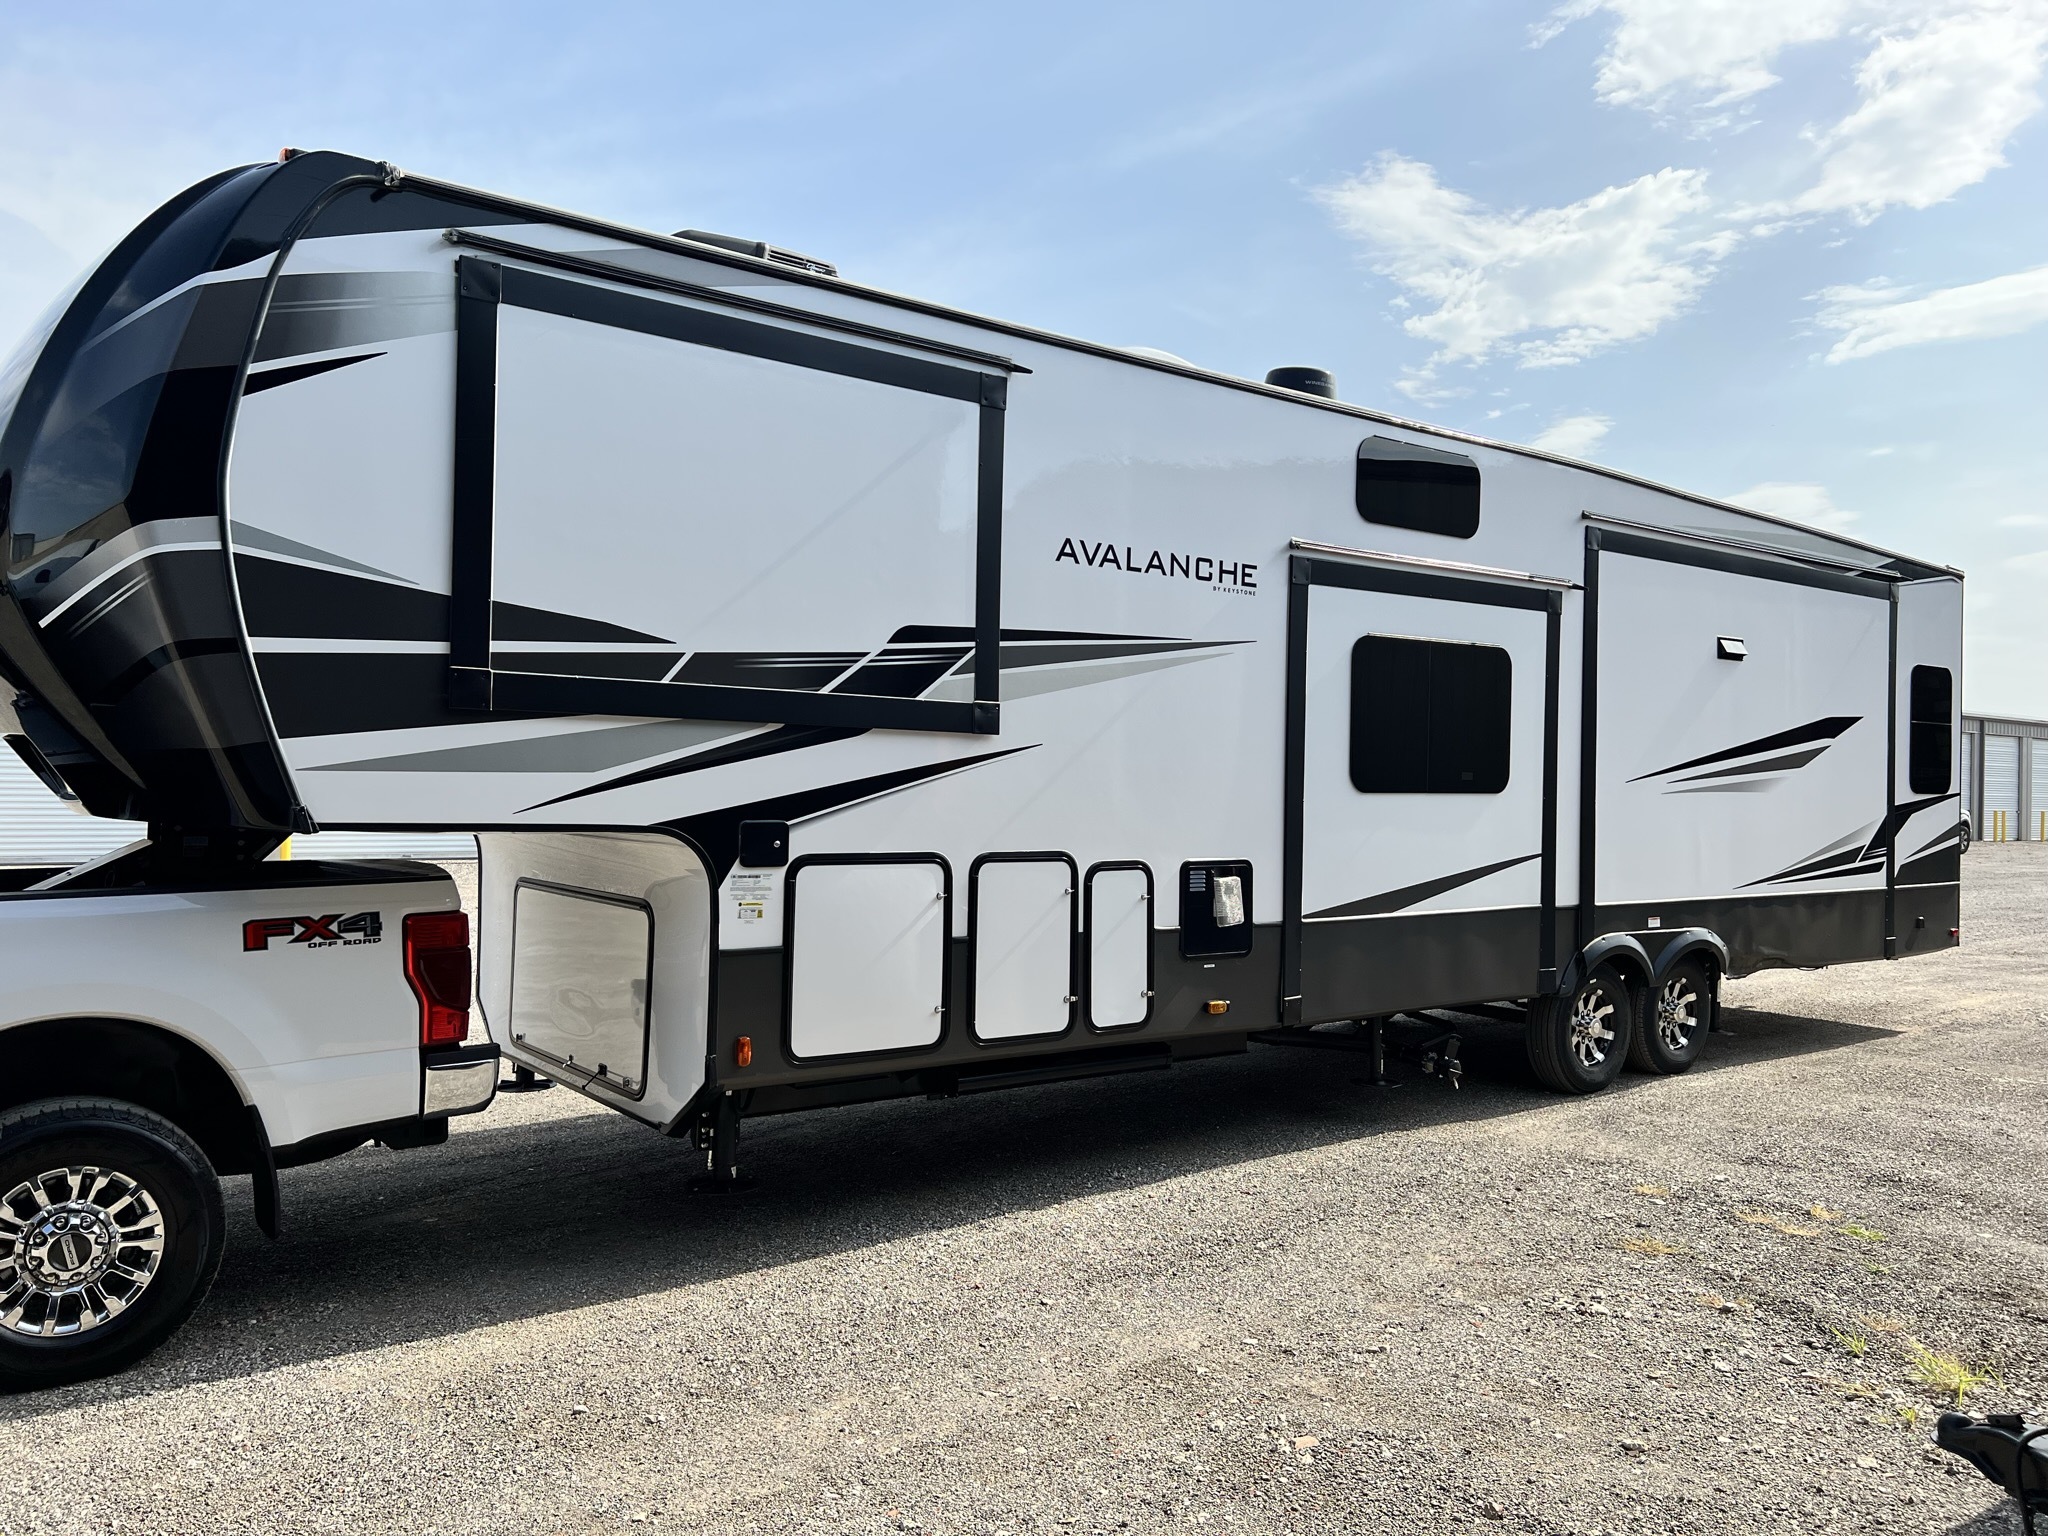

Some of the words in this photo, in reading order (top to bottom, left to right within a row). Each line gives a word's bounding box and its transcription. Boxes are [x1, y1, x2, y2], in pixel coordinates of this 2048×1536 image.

[1055, 537, 1258, 588] AVALANCHE
[1223, 587, 1256, 596] KEYSTONE
[242, 911, 383, 952] FX4
[307, 941, 338, 949] OFF
[342, 937, 382, 946] ROAD
[64, 1239, 76, 1266] FORD
